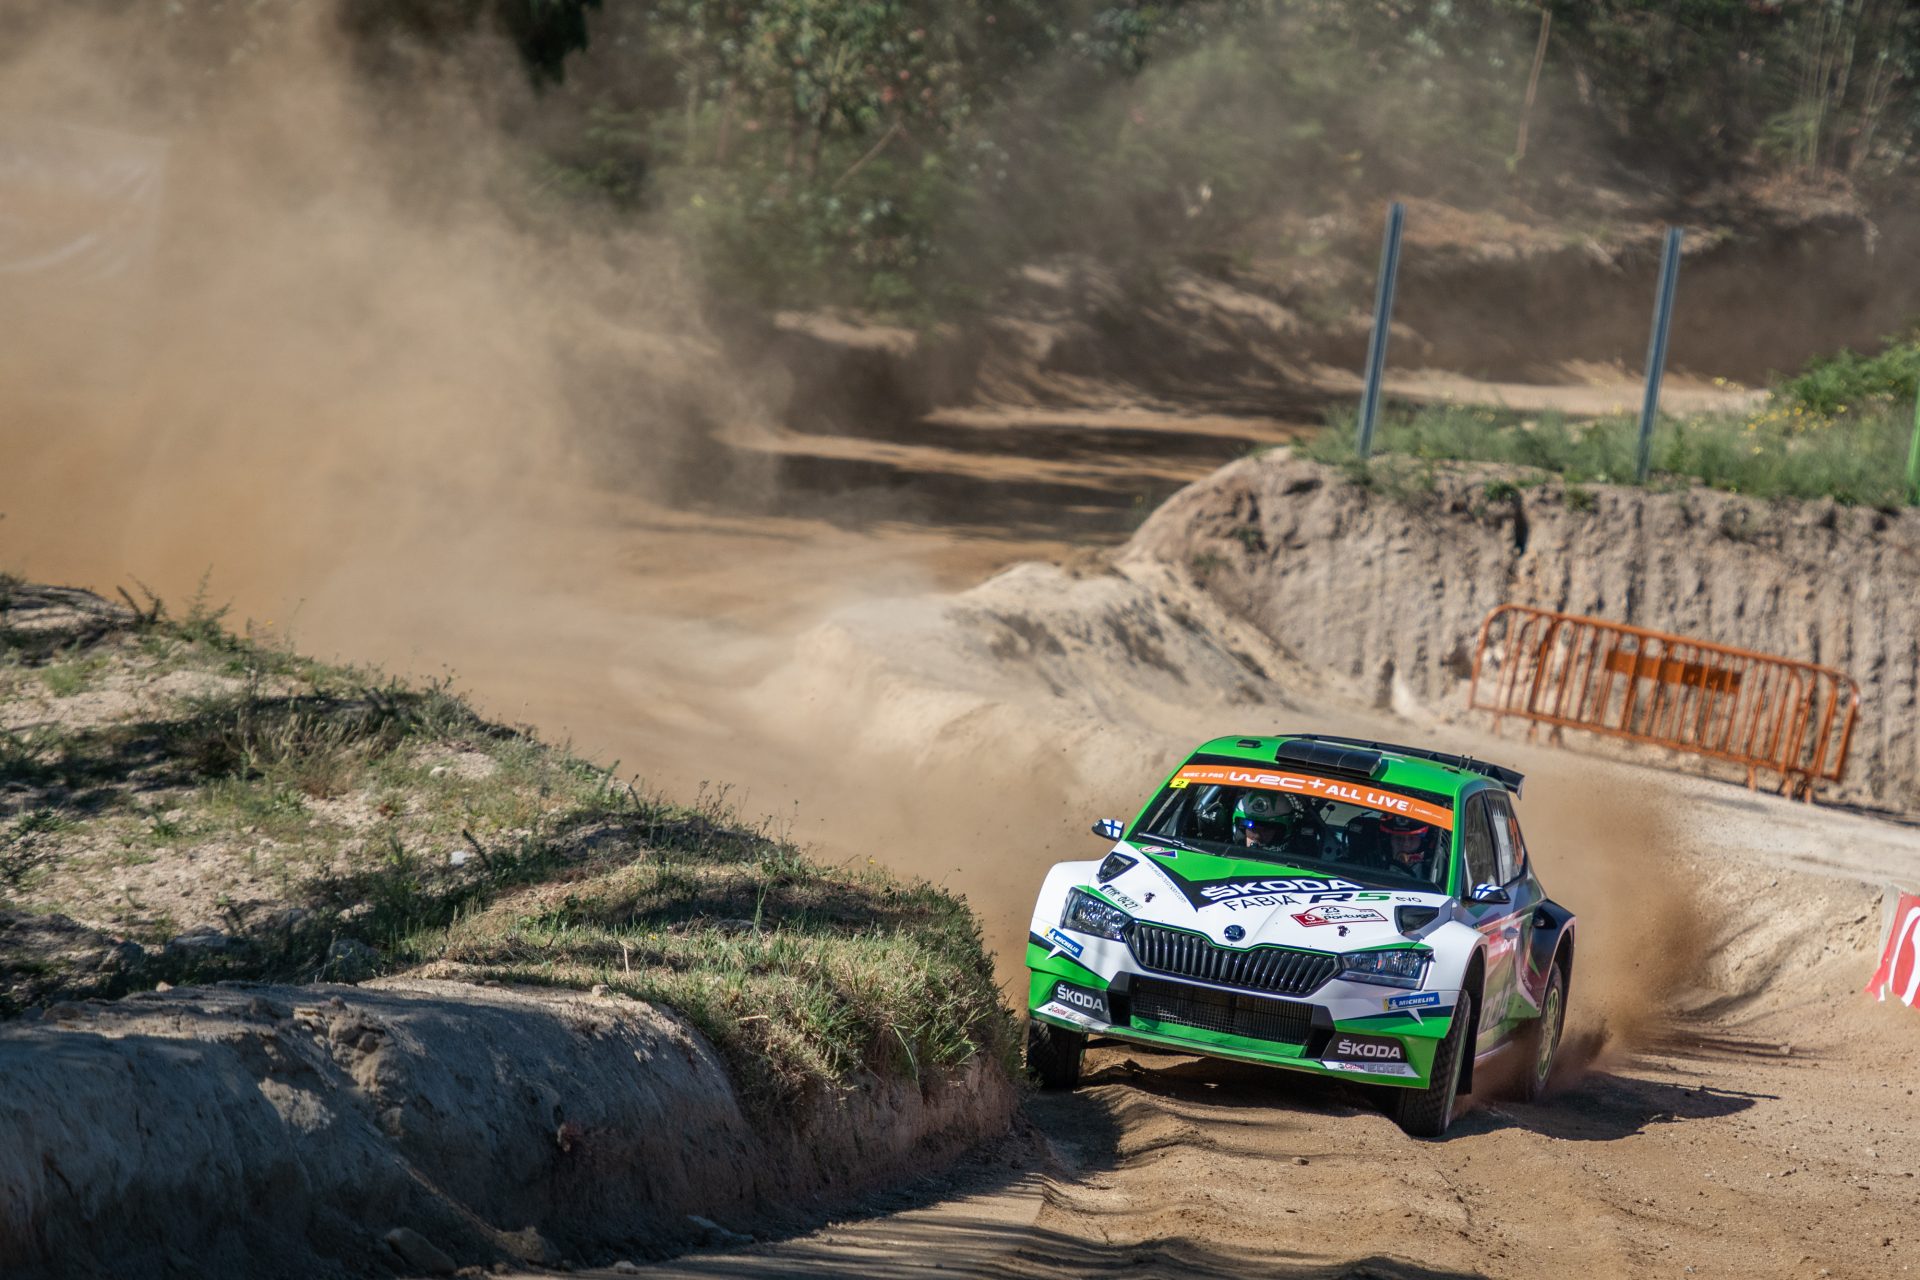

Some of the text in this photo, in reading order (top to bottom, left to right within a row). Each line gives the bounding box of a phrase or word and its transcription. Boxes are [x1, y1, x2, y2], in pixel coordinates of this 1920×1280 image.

[1325, 784, 1361, 800] ALL
[1366, 792, 1409, 811] LIVE
[1200, 880, 1364, 901] ŠKODA
[1223, 894, 1302, 911] FABIA
[1309, 892, 1392, 904] R5
[1054, 935, 1080, 954] MICHELIN
[1057, 984, 1104, 1012] ŠKODA
[1398, 996, 1435, 1006] MICHELIN
[1337, 1039, 1401, 1059] ŠKODA
